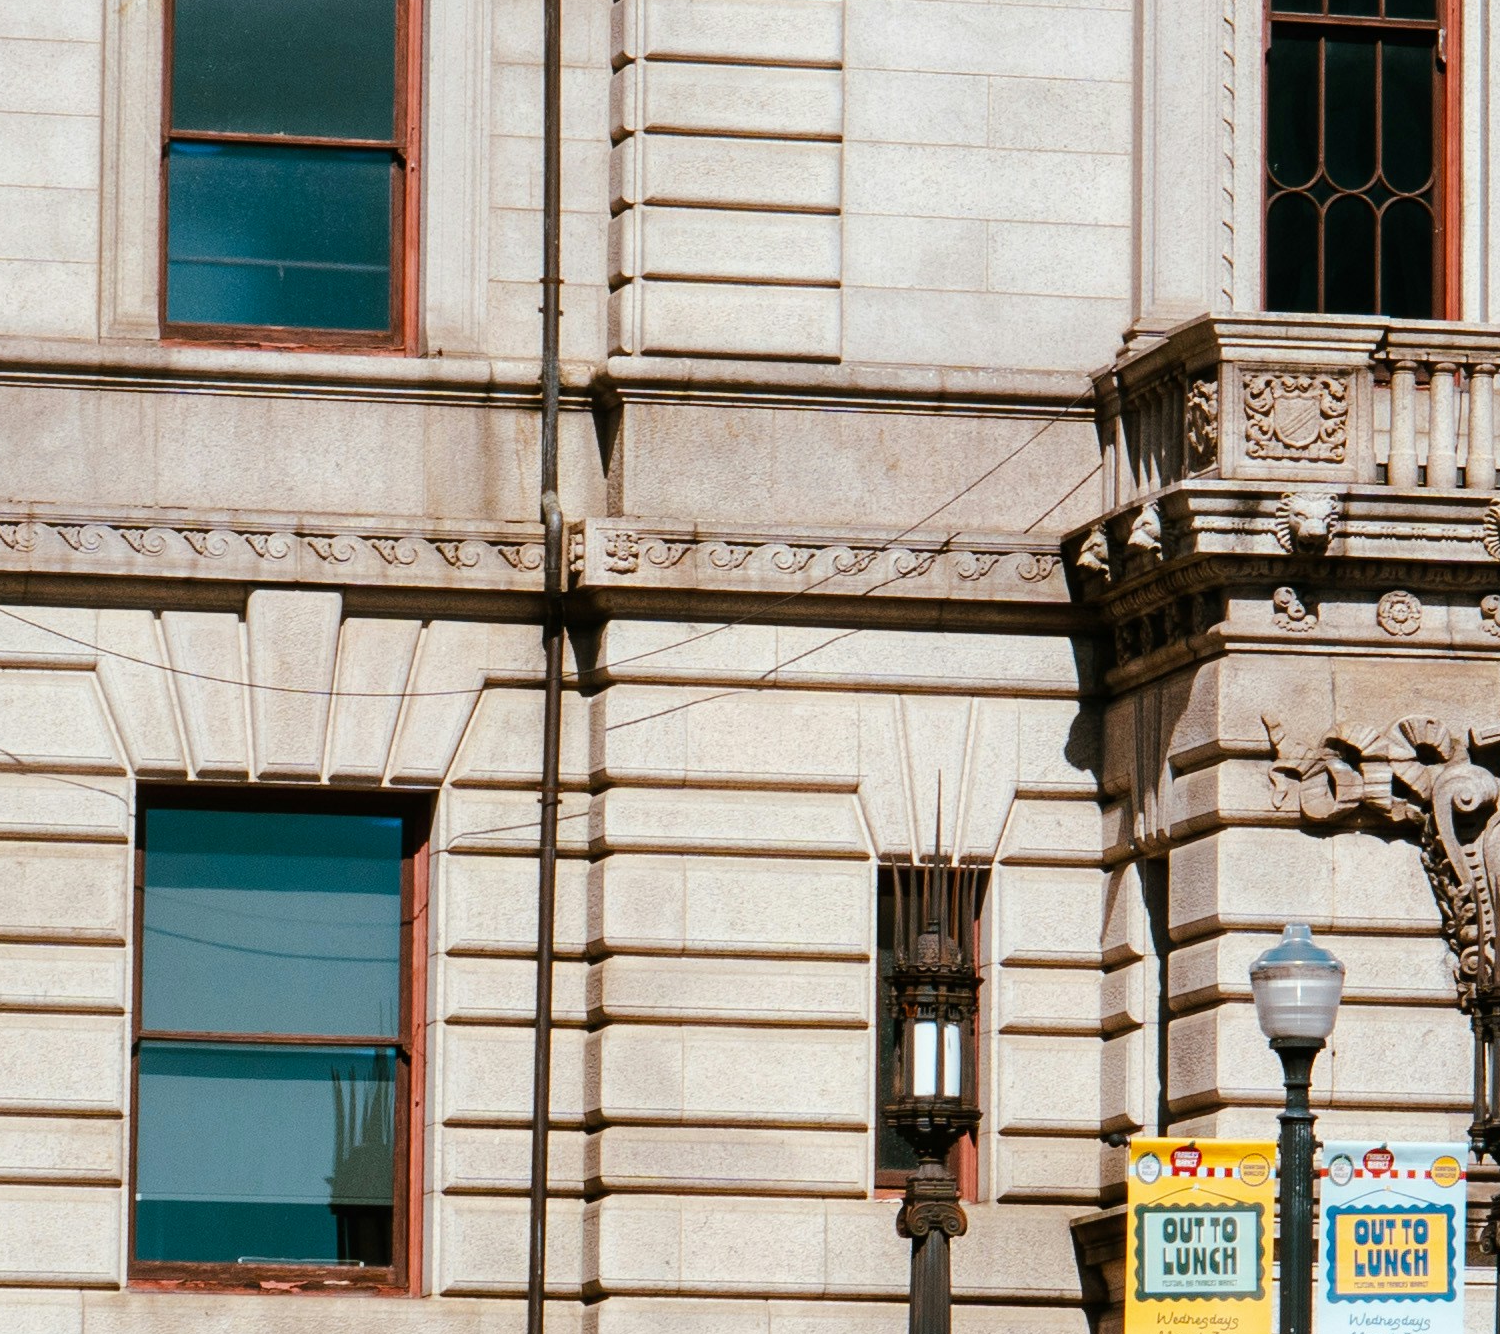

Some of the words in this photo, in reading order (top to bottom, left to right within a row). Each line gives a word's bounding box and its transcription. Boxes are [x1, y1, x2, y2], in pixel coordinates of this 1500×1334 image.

[1162, 1217, 1205, 1244] OUT
[1210, 1216, 1238, 1243] TO
[1354, 1218, 1396, 1246] OUT
[1401, 1218, 1429, 1245] TO
[1162, 1247, 1238, 1276] LUNCH
[1354, 1248, 1429, 1277] LUNCH
[1156, 1311, 1239, 1331] Wednesdays
[1349, 1312, 1431, 1332] Wednesdays
